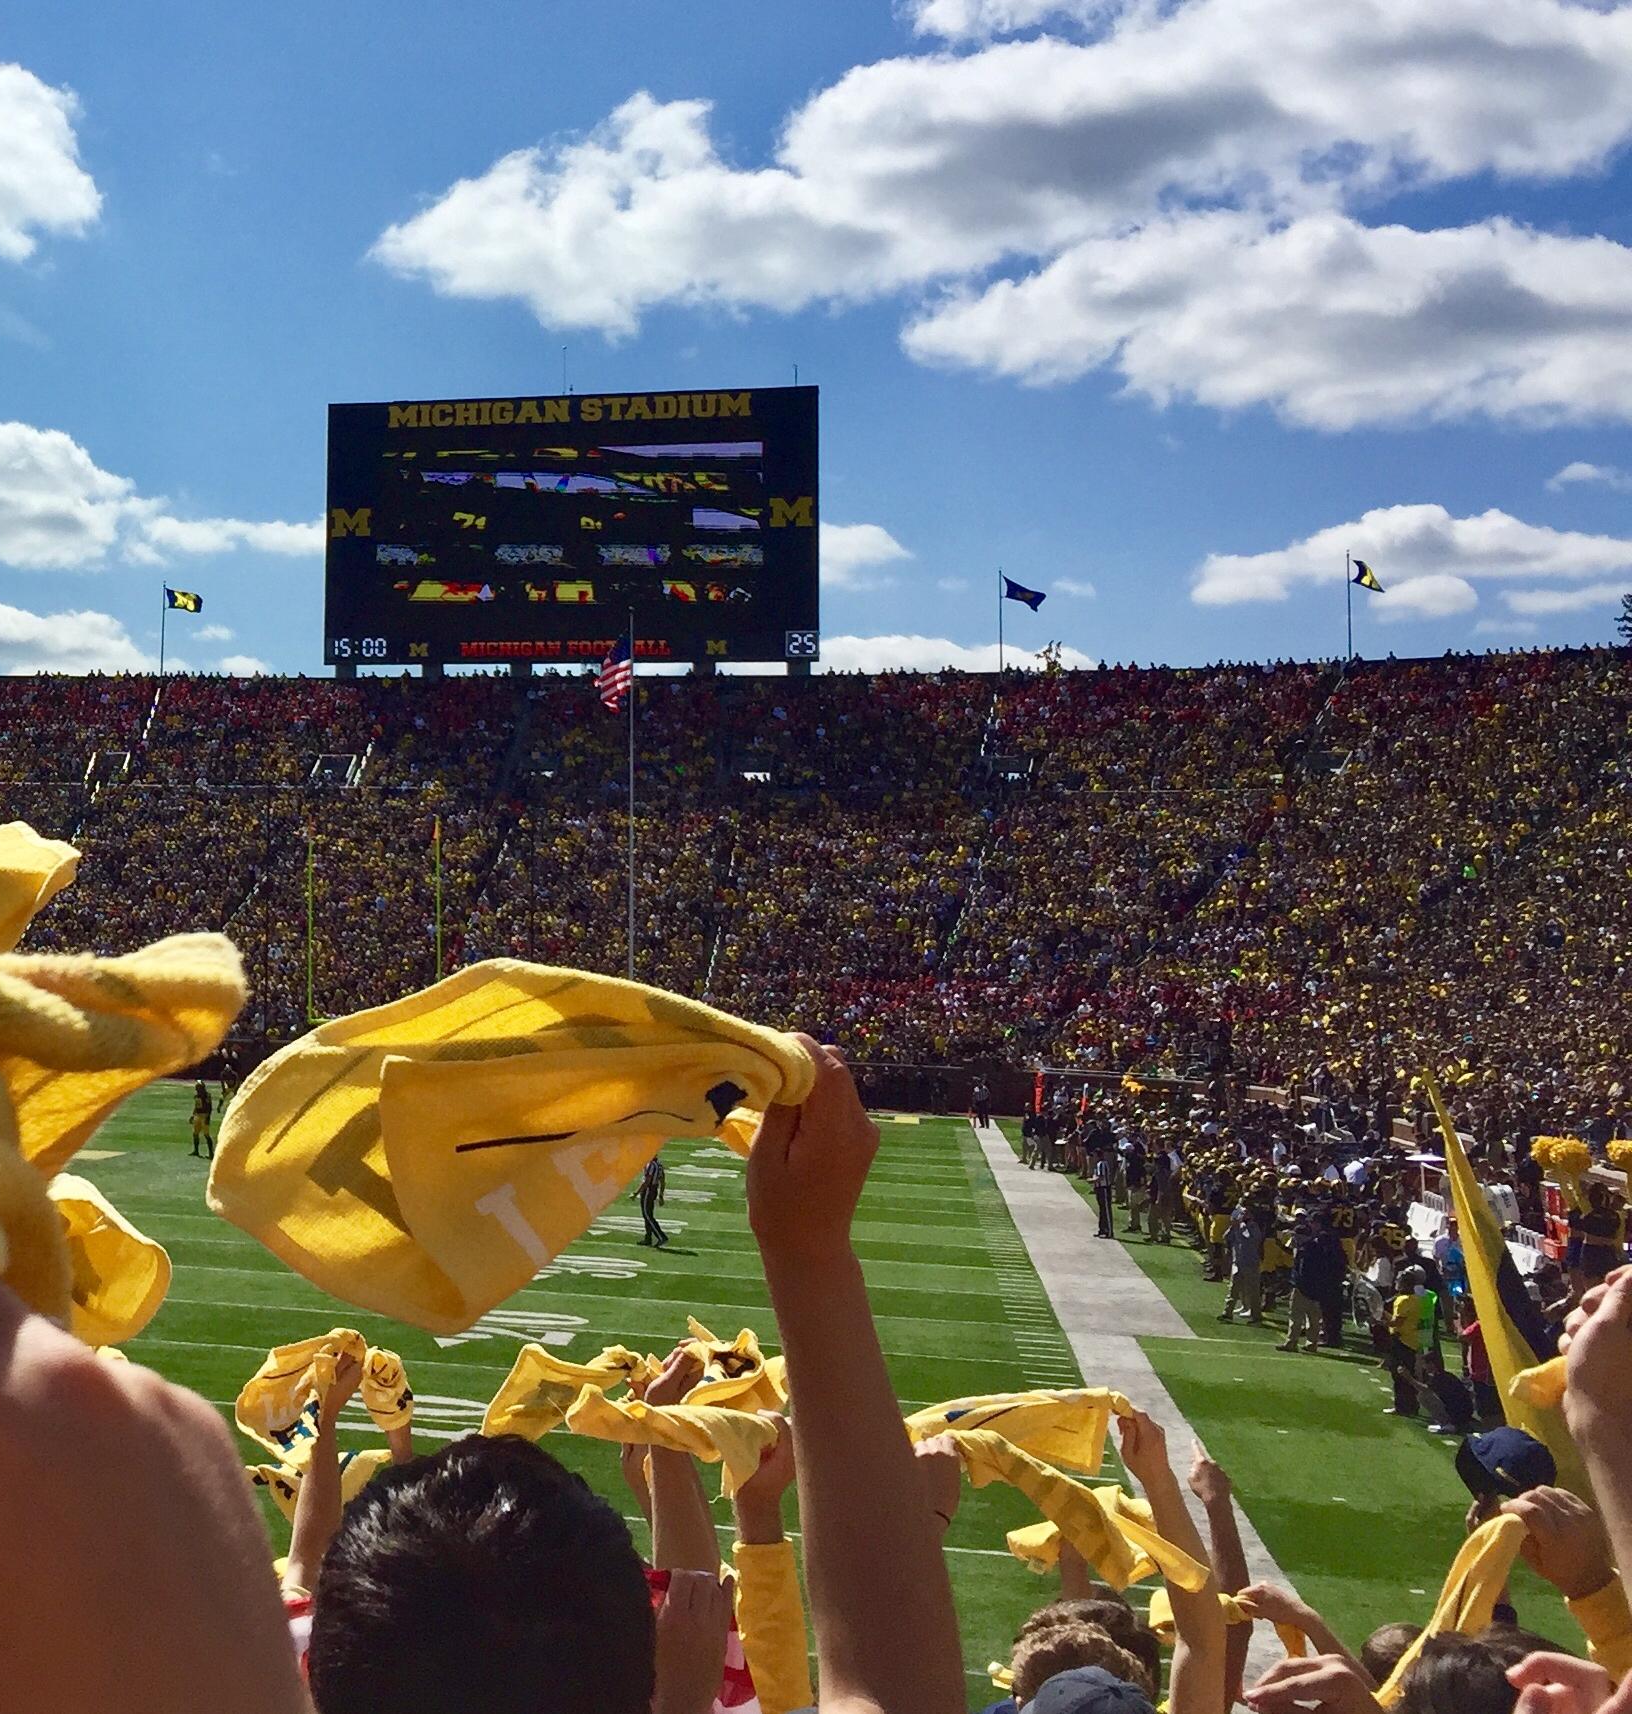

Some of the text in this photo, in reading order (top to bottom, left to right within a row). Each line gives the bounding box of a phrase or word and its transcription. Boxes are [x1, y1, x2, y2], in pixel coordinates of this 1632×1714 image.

[388, 392, 752, 428] MICHIGAN STADIUM
[769, 496, 813, 527] M
[331, 508, 372, 537] M
[334, 638, 387, 657] 15:00
[408, 643, 429, 656] M
[460, 639, 672, 656] MICHIGAN FOOTALL
[706, 640, 728, 655] M
[789, 633, 816, 654] 25
